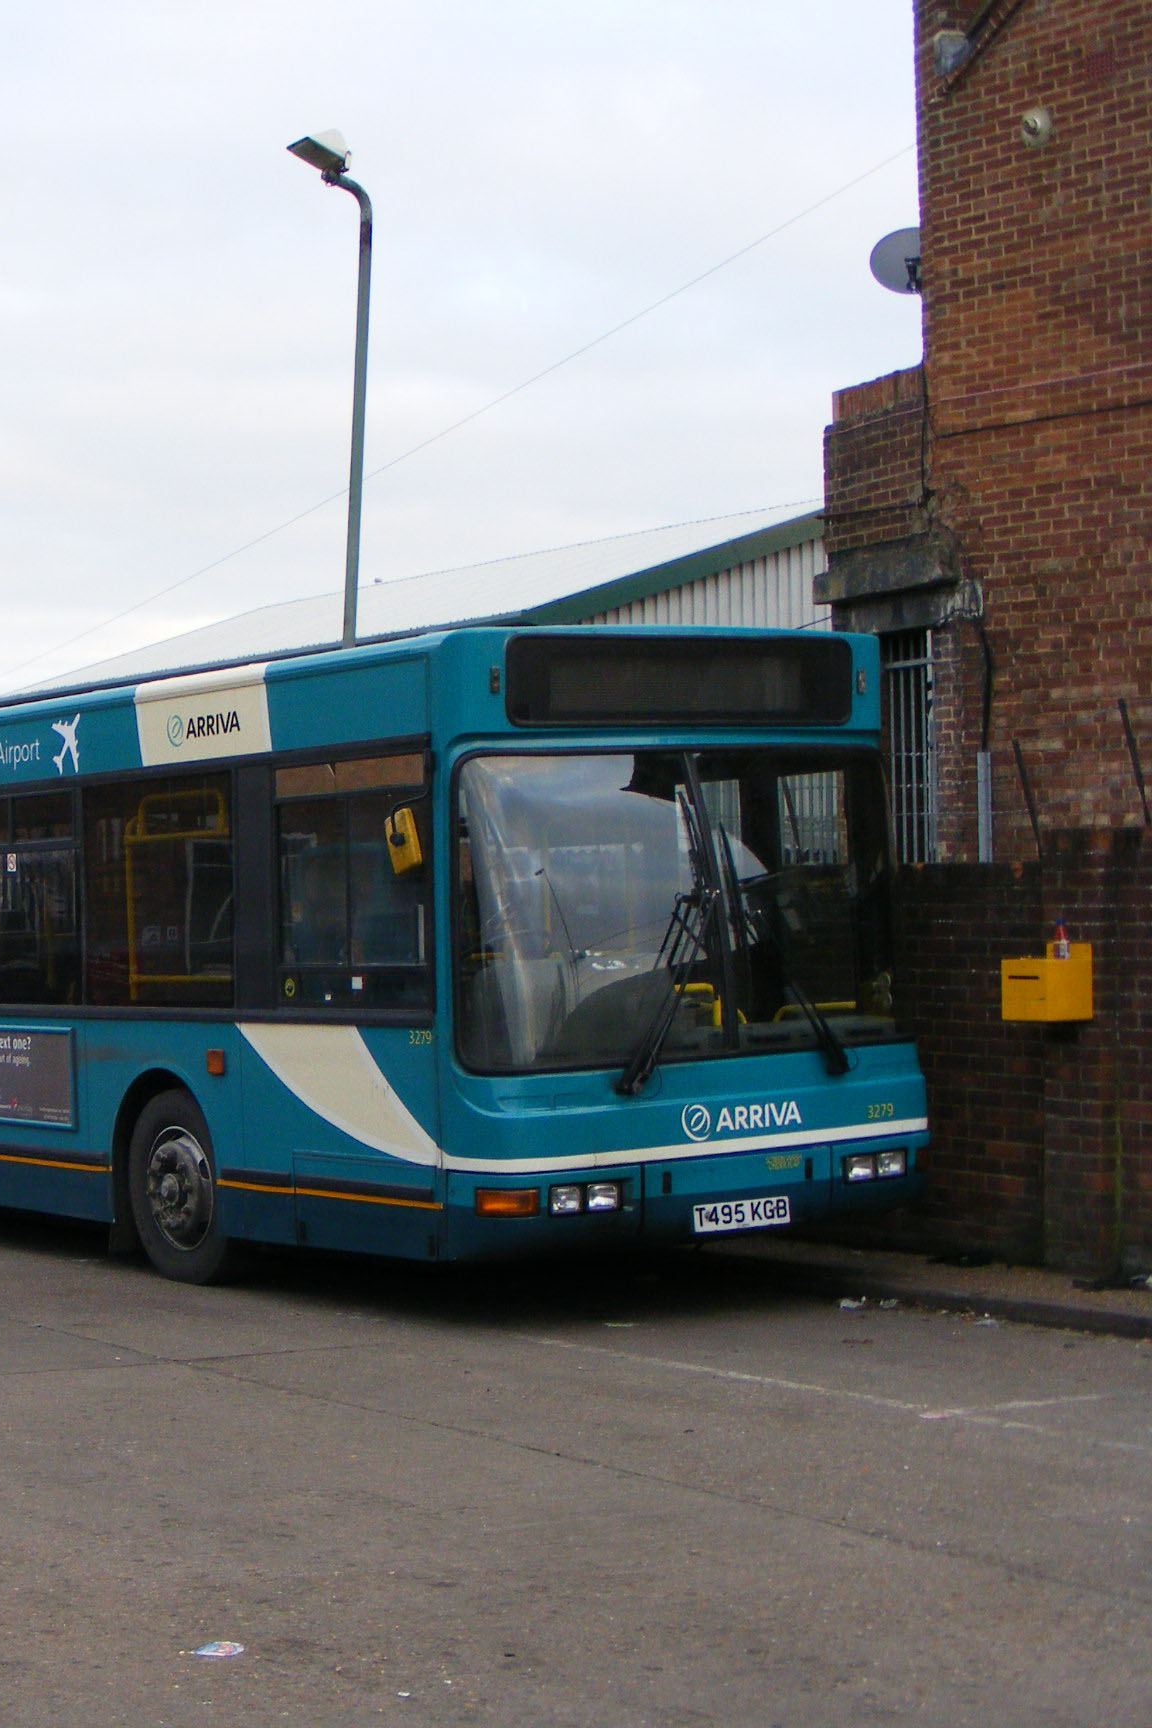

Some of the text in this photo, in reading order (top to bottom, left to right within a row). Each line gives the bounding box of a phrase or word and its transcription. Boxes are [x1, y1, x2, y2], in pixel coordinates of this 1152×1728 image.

[186, 711, 241, 739] ARRIVA
[12, 1036, 32, 1050] one?
[409, 1030, 432, 1045] 3279
[716, 1101, 802, 1132] ARRIVA
[867, 1103, 894, 1119] 3279
[695, 1199, 788, 1227] T495 KGB
